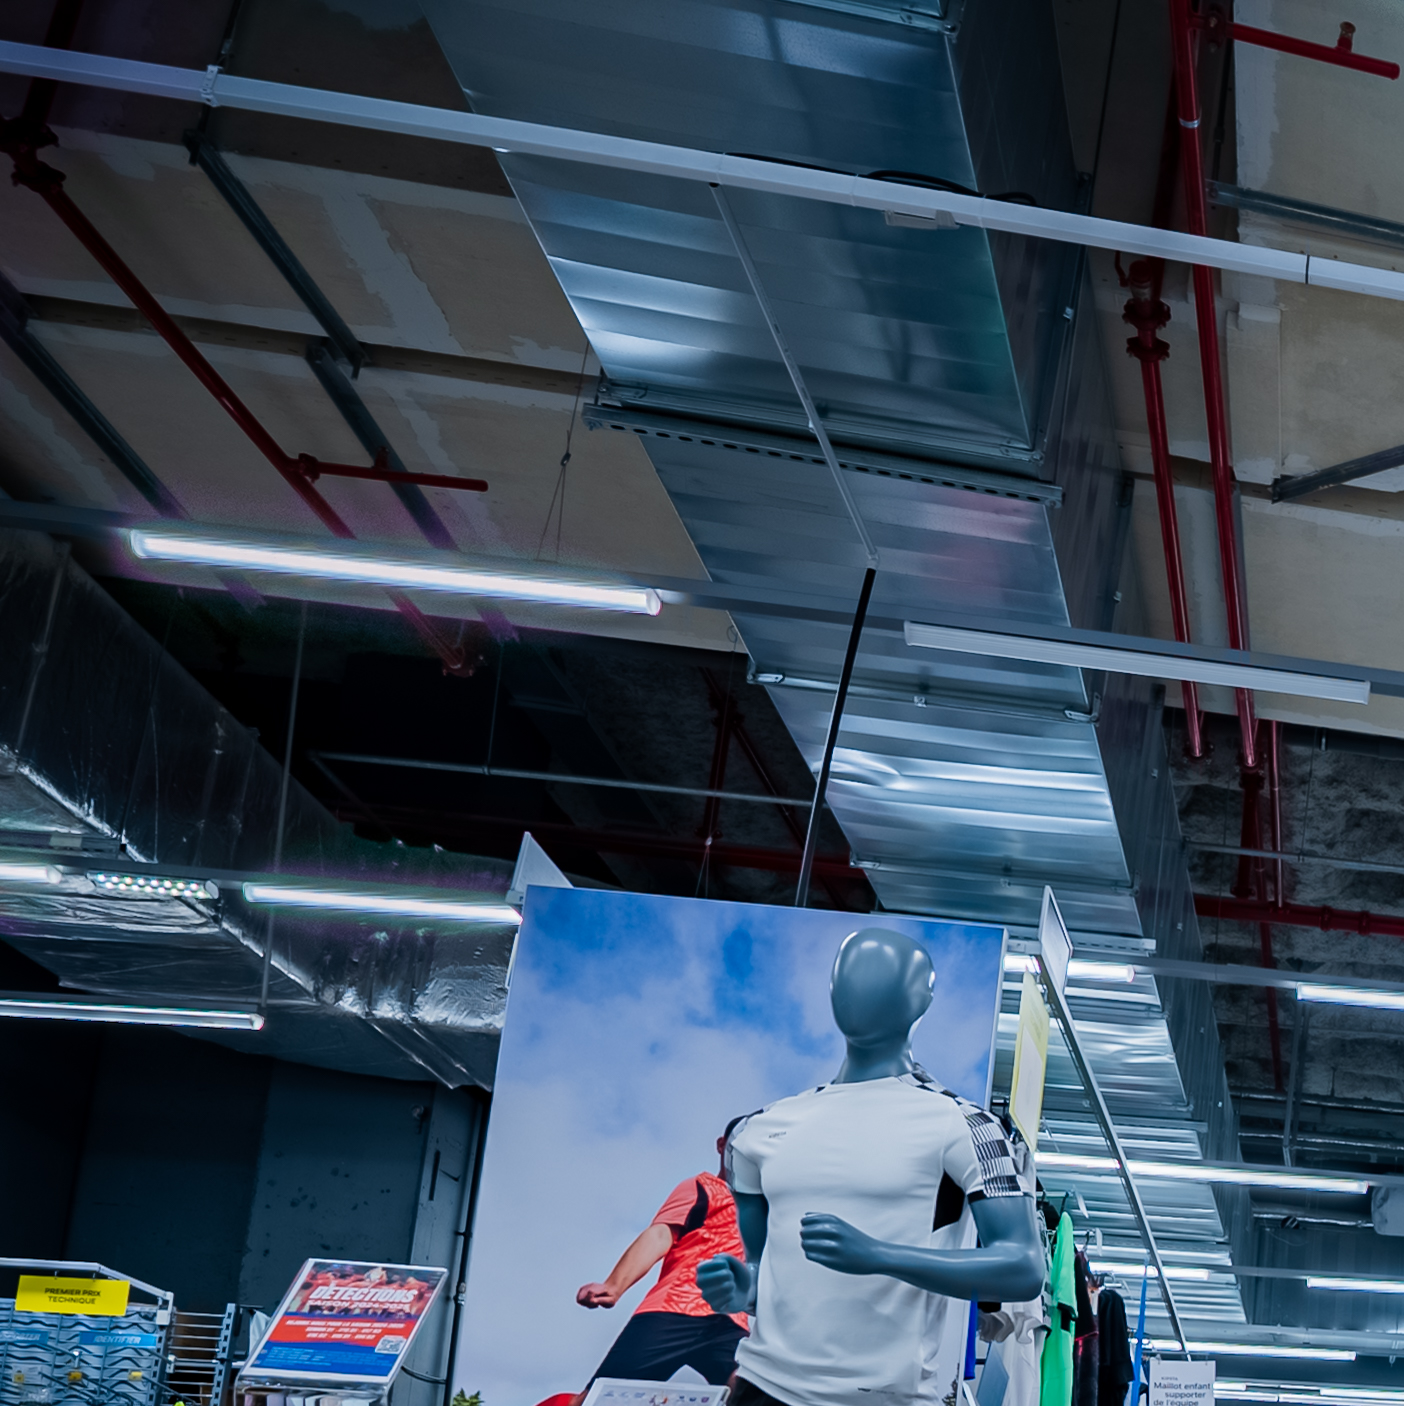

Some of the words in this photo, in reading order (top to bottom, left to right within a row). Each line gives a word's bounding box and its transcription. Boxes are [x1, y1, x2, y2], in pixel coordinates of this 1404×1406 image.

[44, 1288, 82, 1296] PREMIER
[82, 1288, 101, 1297] PRIX
[309, 1281, 418, 1303] DÉTECTIONS
[1154, 1382, 1183, 1390] Maillot
[1184, 1382, 1212, 1390] enfant
[1165, 1391, 1206, 1400] supporter
[1153, 1399, 1164, 1406] de
